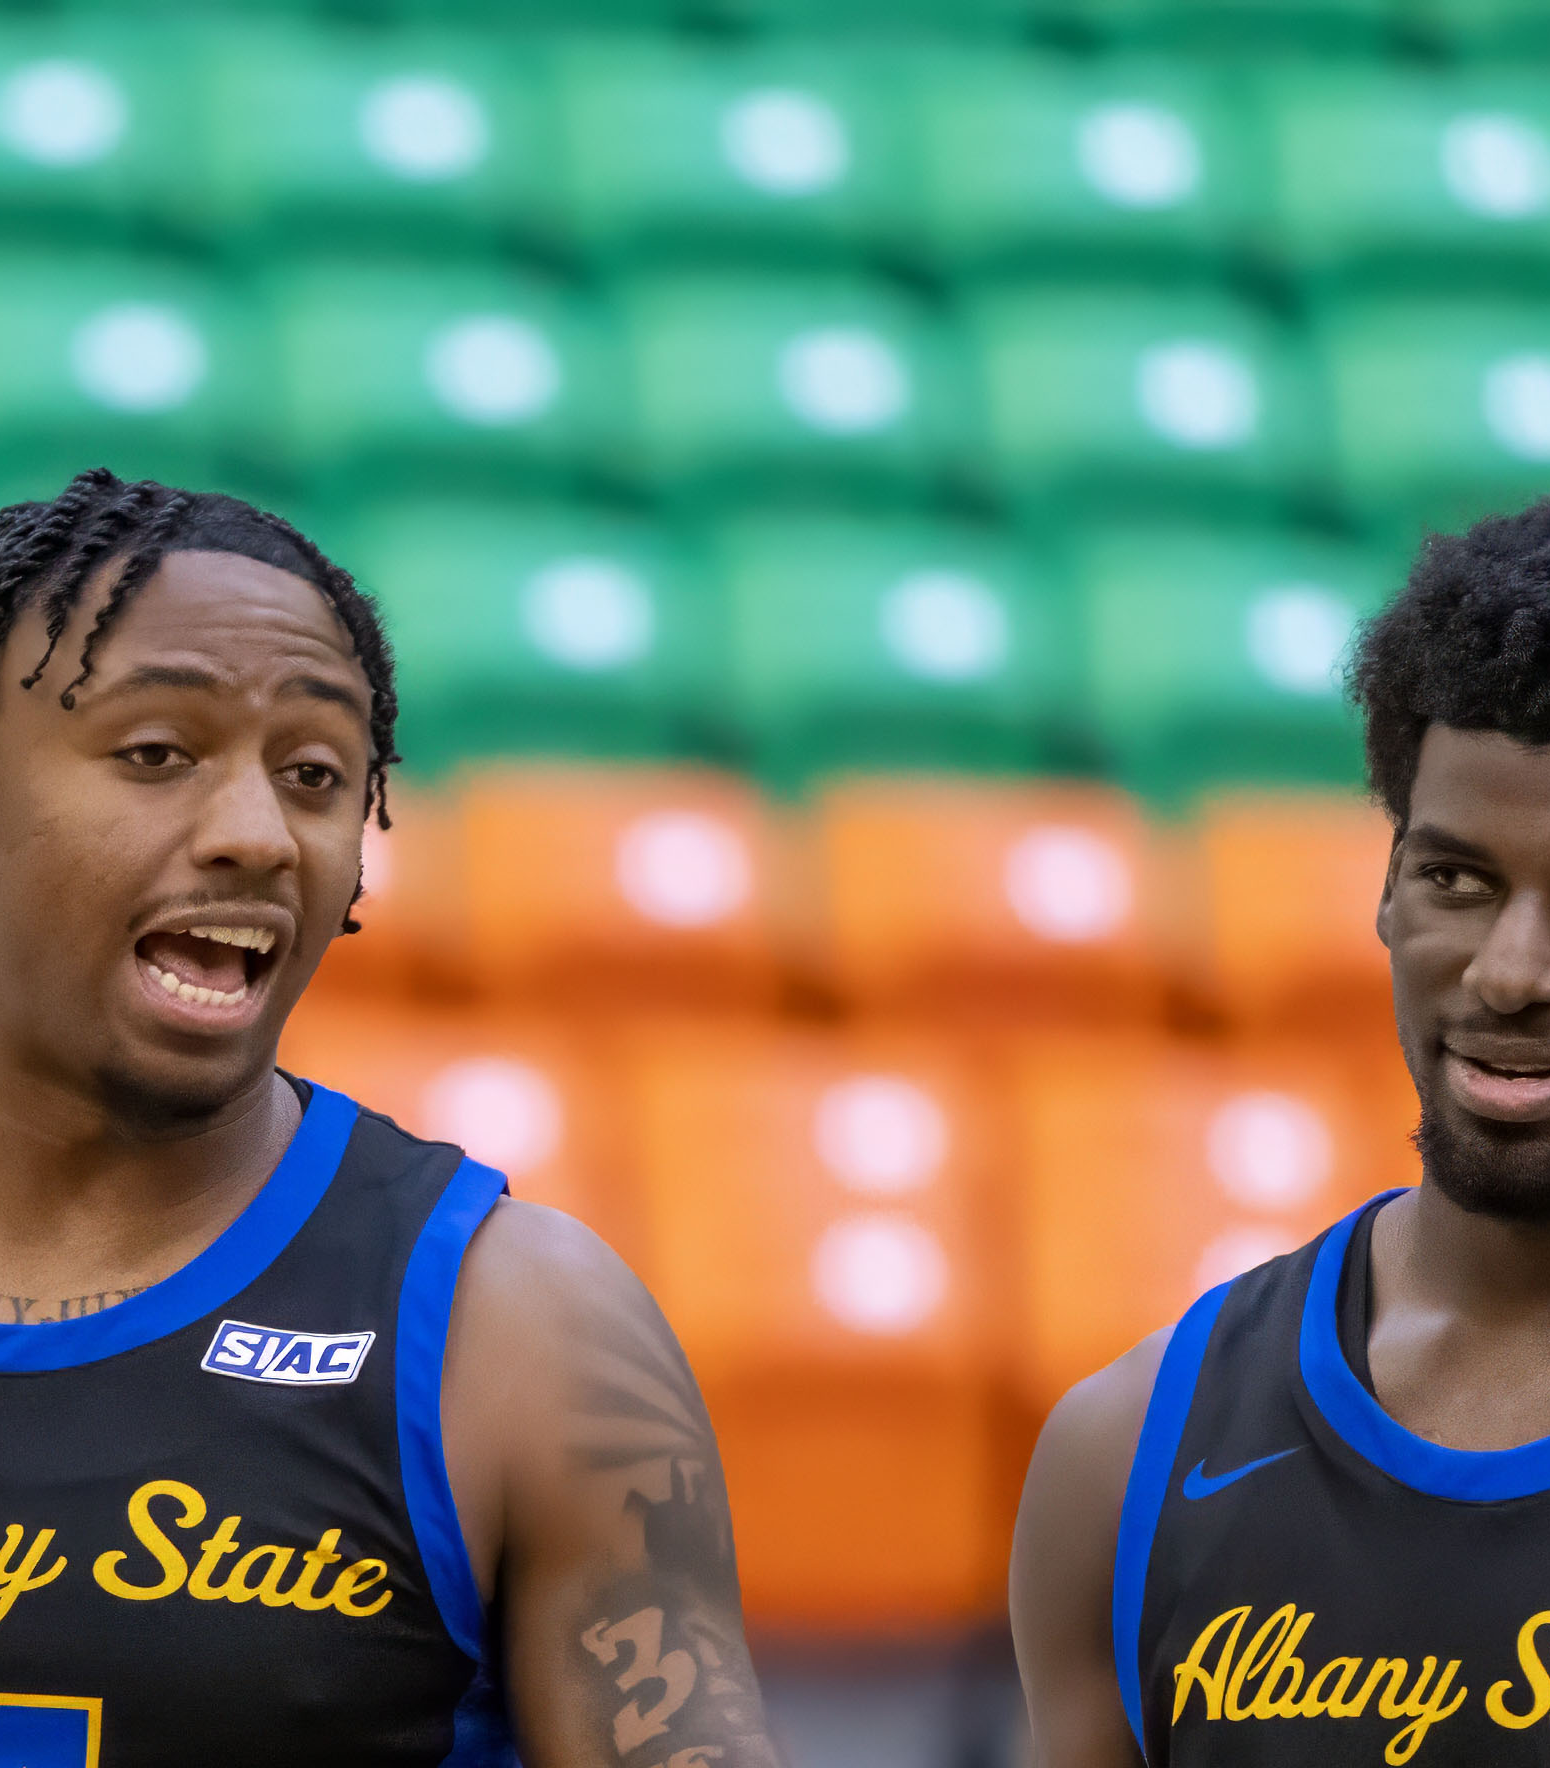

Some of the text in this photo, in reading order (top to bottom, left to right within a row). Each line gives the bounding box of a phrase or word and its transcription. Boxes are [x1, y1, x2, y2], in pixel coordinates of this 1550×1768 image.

[213, 1329, 361, 1376] SIAC
[91, 1479, 394, 1618] State
[1171, 1602, 1469, 1767] Albany
